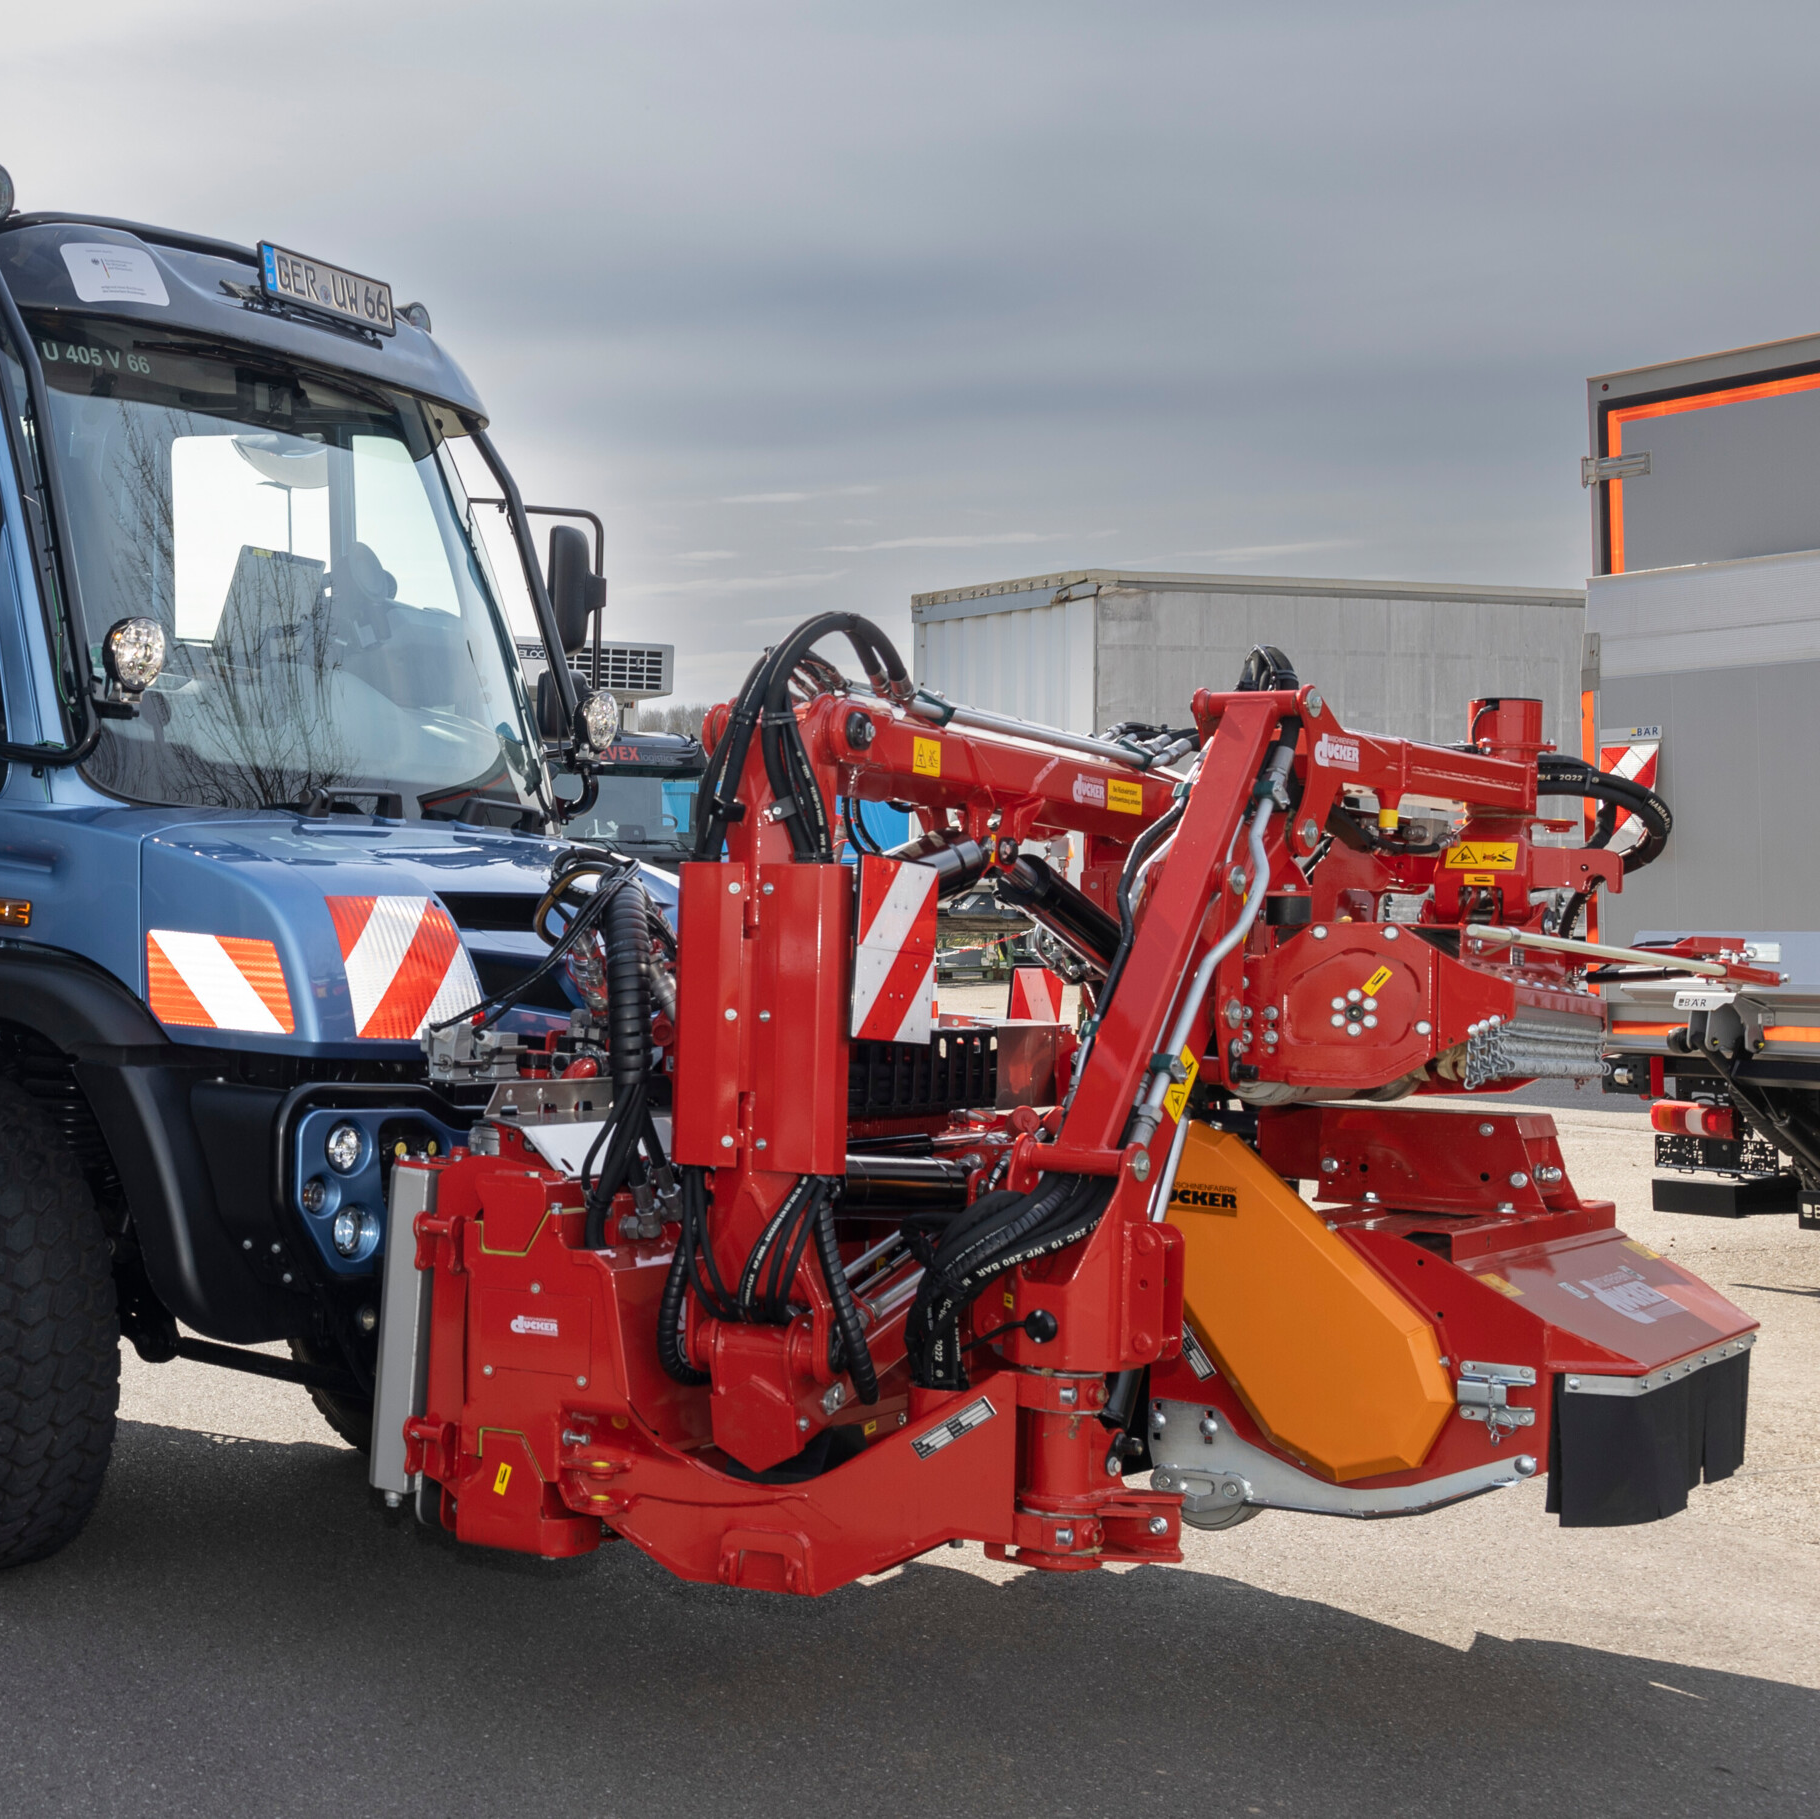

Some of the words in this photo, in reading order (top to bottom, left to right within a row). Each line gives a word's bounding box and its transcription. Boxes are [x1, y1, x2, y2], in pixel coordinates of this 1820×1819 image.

[277, 255, 320, 300] GER
[331, 273, 358, 314] UW
[364, 286, 388, 322] 66
[42, 342, 58, 360] U
[66, 345, 102, 366] 405
[106, 350, 120, 368] V
[127, 354, 150, 374] 66
[1636, 726, 1658, 737] BÄR
[1066, 1227, 1088, 1242] 2SC
[1050, 1239, 1064, 1249] 19
[1026, 1246, 1046, 1258] WP
[1002, 1254, 1023, 1266] 280
[976, 1262, 1000, 1277] BAR
